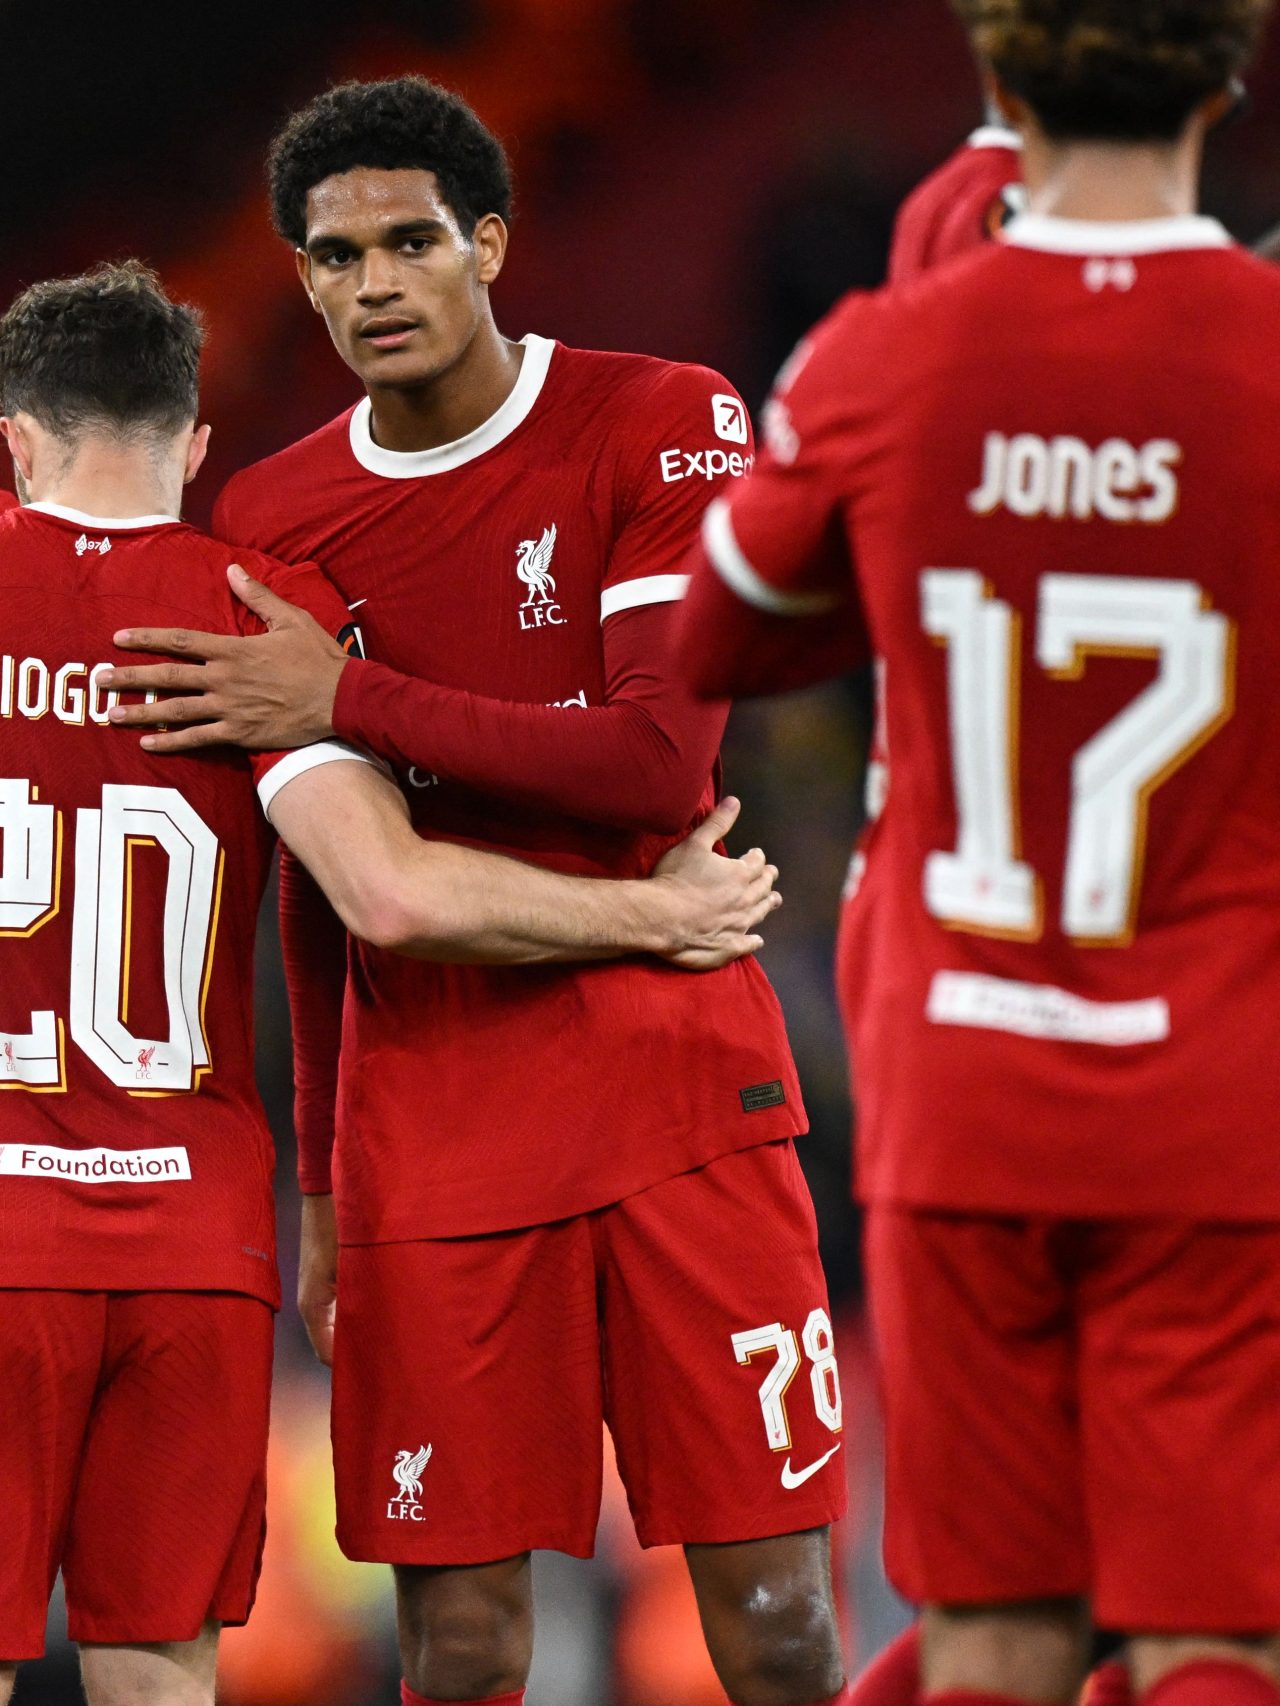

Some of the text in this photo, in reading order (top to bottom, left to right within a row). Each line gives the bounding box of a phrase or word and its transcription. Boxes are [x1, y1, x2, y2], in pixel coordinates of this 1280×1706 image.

[518, 604, 568, 630] L.F.C.
[920, 568, 1237, 948] 17
[21, 1150, 180, 1176] Foundation
[731, 1307, 842, 1452] 78
[387, 1502, 426, 1521] L.F.C.
